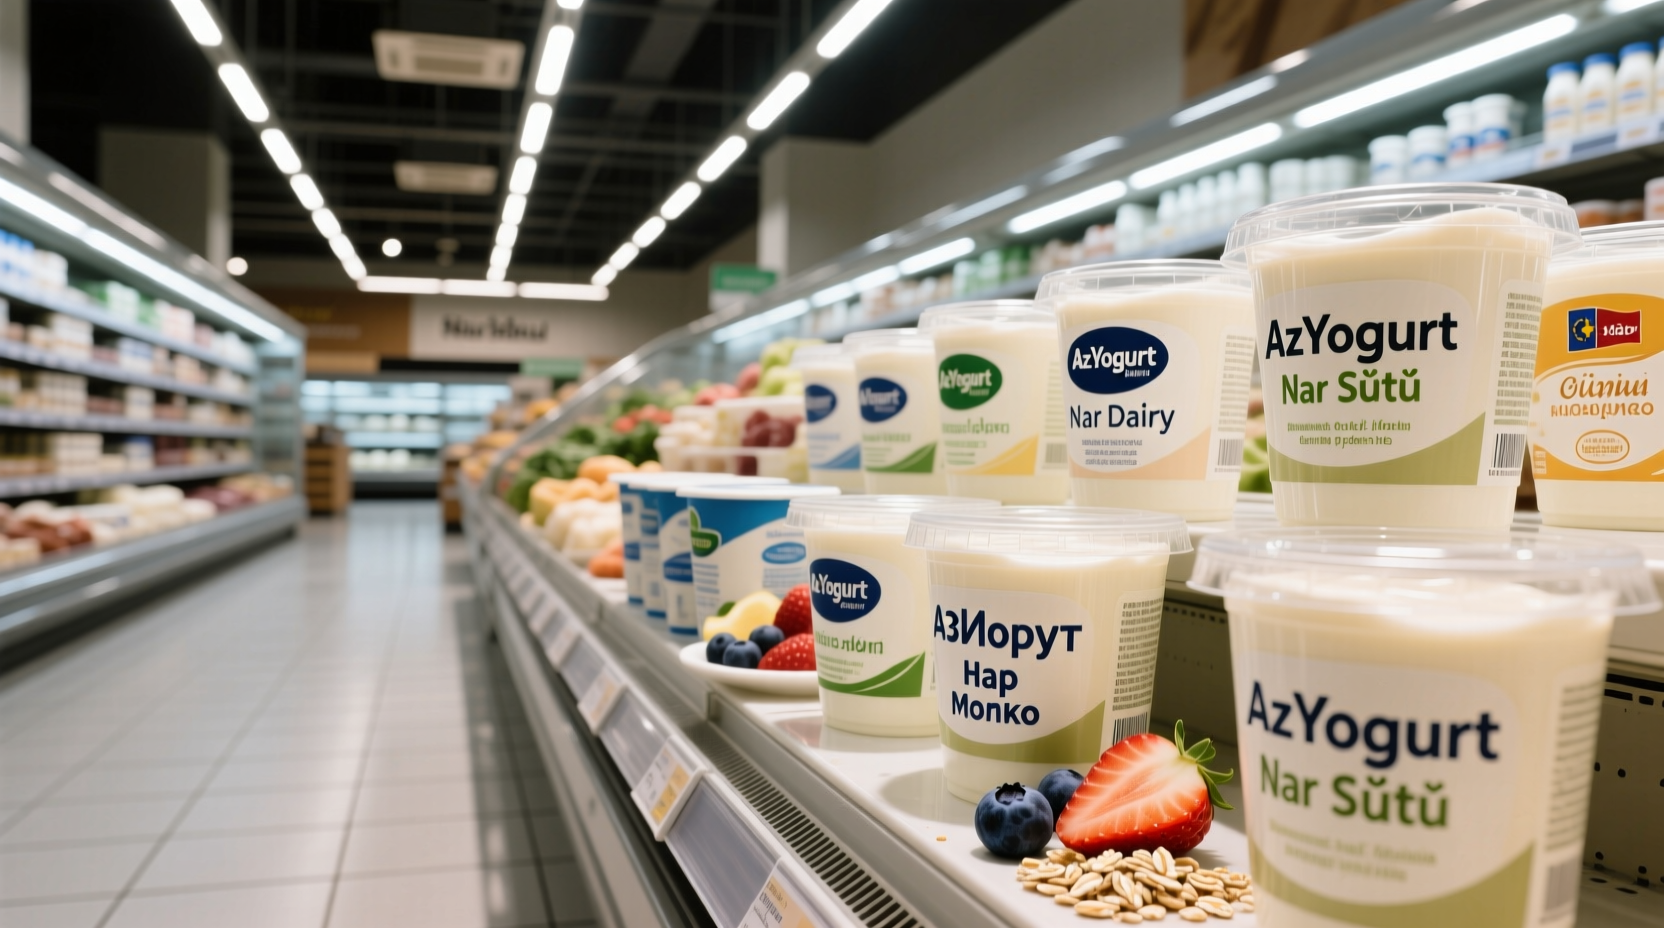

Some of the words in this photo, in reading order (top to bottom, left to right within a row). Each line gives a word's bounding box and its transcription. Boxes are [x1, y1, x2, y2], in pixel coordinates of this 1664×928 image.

[1265, 312, 1458, 364] AzYogurt
[1072, 346, 1157, 374] AzYogurt
[1281, 374, 1329, 405] Nar
[1070, 405, 1102, 429] Nar
[1108, 402, 1175, 434] Dairy
[963, 659, 1018, 697] Нар
[1247, 681, 1499, 768] AzYogurt
[1261, 755, 1319, 806] Nar
